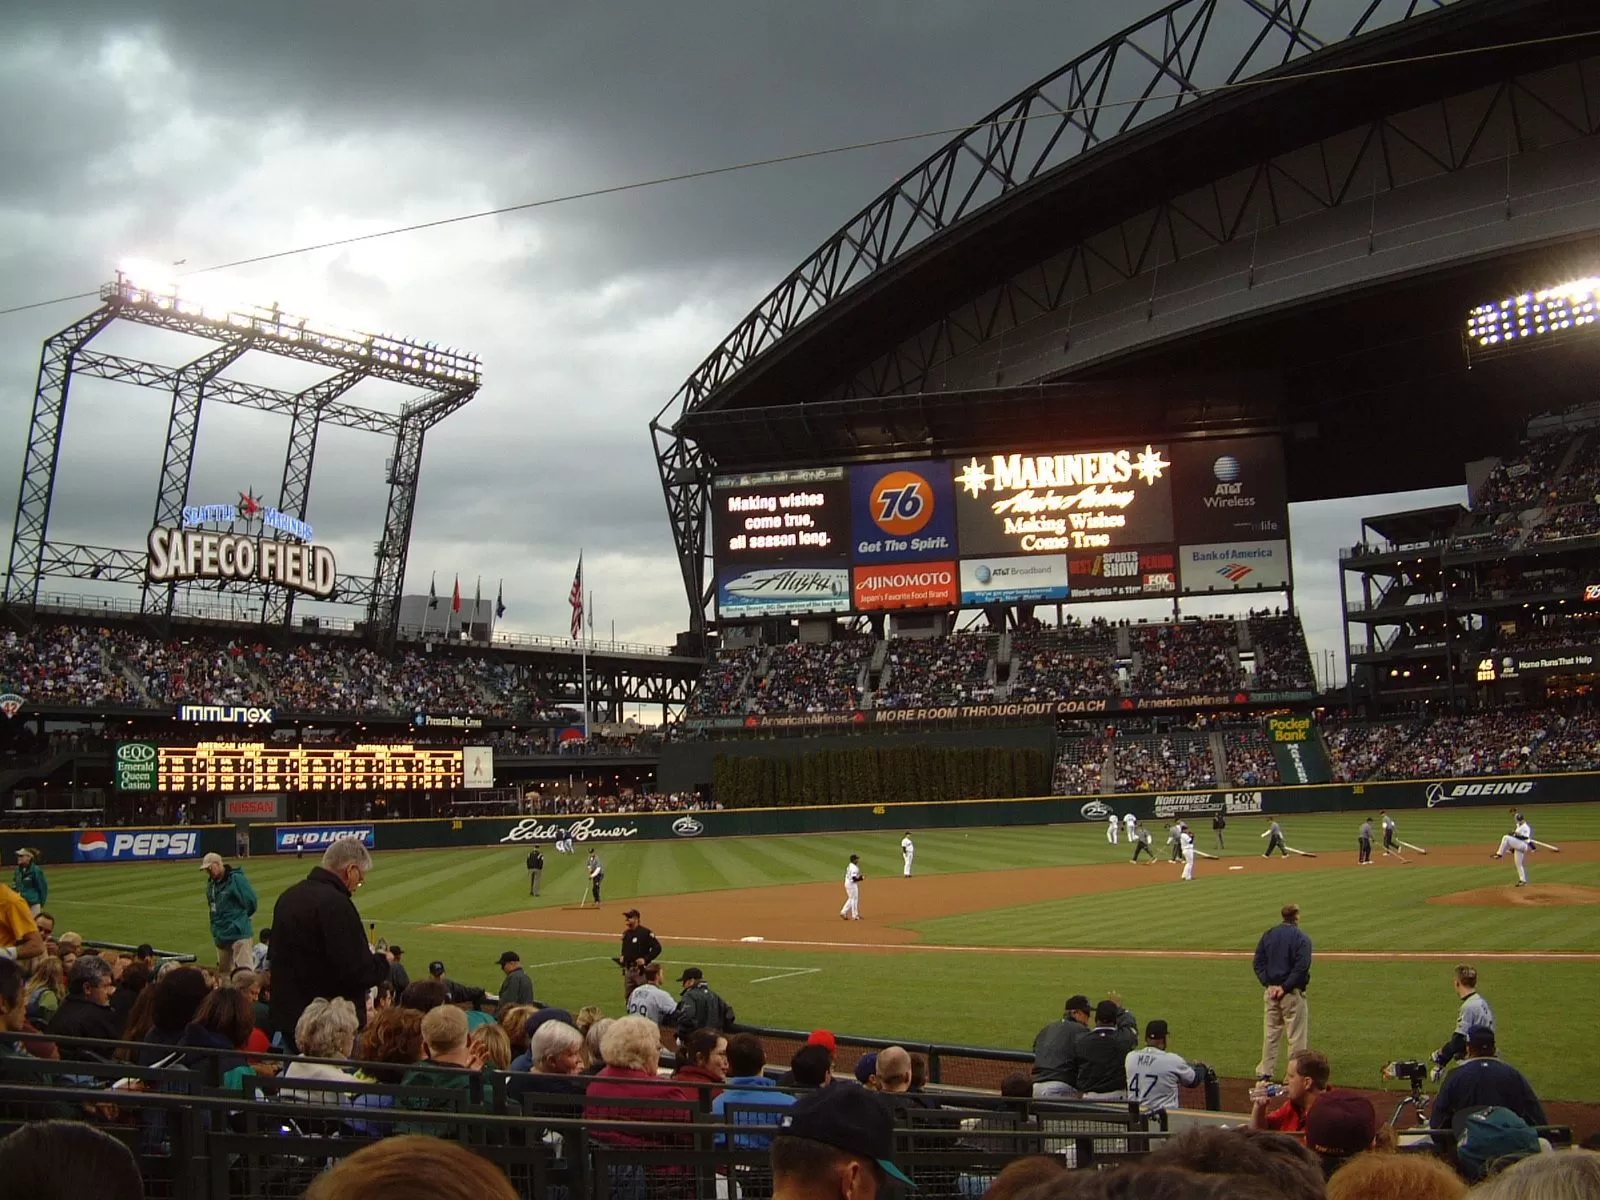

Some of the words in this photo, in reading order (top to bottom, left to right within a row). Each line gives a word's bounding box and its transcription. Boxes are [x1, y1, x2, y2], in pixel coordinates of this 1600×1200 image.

[992, 450, 1133, 491] MARINERS
[1215, 482, 1243, 495] AT&T
[728, 496, 777, 511] Making
[779, 492, 824, 508] wishes
[877, 482, 924, 521] 76
[1204, 496, 1256, 508] Wireless
[183, 504, 236, 526] SEATTLE
[745, 516, 782, 530] come
[784, 513, 815, 527] true,
[1004, 515, 1066, 535] Making
[1068, 511, 1125, 530] Wishes
[730, 535, 746, 550] all
[749, 533, 796, 548] season
[799, 531, 831, 547] long.
[858, 541, 881, 553] Get
[884, 540, 907, 551] The
[911, 536, 949, 551] Spirit.
[1021, 534, 1069, 551] Come
[1071, 531, 1110, 548] True
[147, 527, 255, 583] SAFECO
[258, 538, 336, 596] FIELD
[1103, 551, 1138, 563] SPORTS
[1192, 550, 1219, 562] Bank
[1219, 550, 1229, 560] of
[1230, 548, 1272, 559] America
[992, 568, 1010, 576] AT&T
[1011, 565, 1052, 575] Broadband
[1103, 562, 1138, 577] SHOW
[752, 570, 832, 594] Alaska
[856, 571, 952, 591] AJINOMOTO
[1148, 573, 1170, 585] FOX
[911, 591, 928, 599] Food
[928, 590, 949, 598] Brand
[1519, 661, 1539, 669] Home
[1558, 657, 1574, 666] That
[875, 710, 914, 722] MORE
[917, 708, 958, 720] ROOM
[961, 703, 1053, 717] THROUGHOUT
[1057, 700, 1106, 713] COACH
[451, 716, 465, 726] Blue
[465, 716, 482, 727] Cross
[1270, 718, 1310, 730] Pocket
[1275, 729, 1306, 741] Bank
[122, 745, 153, 760] EQC
[117, 762, 154, 772] Emerald
[121, 771, 150, 782] Queen
[120, 780, 151, 790] Casino
[1451, 781, 1532, 797] BOEING
[1155, 794, 1212, 805] NORTHWEST
[229, 801, 273, 813] NISSAN
[1087, 807, 1108, 816] 25
[568, 817, 638, 842] Bauer
[677, 822, 699, 832] 25
[320, 830, 370, 842] LIGHT
[112, 832, 195, 856] PEPSI
[1137, 1055, 1156, 1067] MAY
[1129, 1072, 1159, 1099] 47
